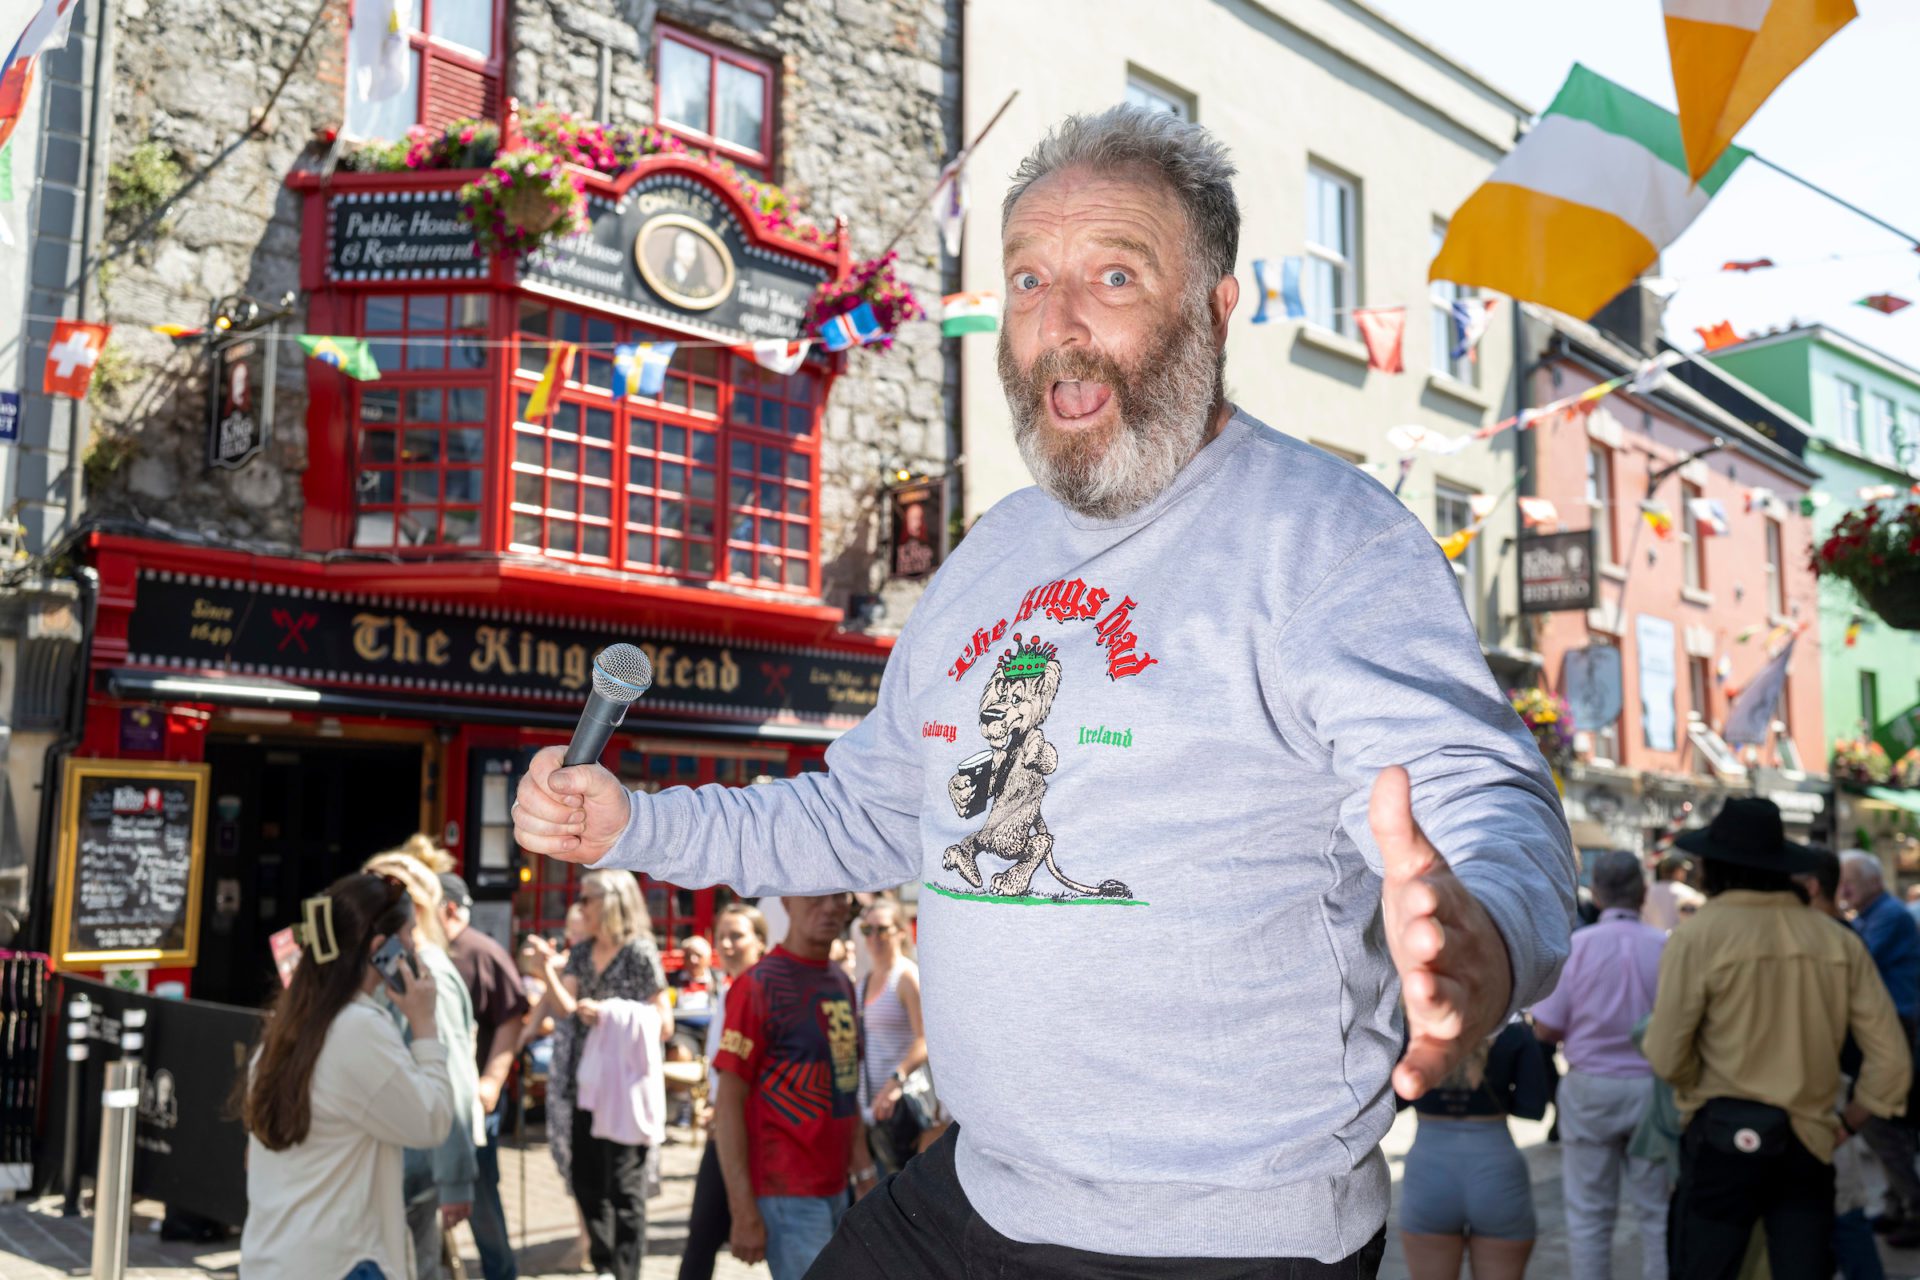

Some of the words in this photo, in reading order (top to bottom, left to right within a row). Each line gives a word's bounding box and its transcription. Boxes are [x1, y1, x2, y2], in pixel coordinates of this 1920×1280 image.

[345, 211, 408, 238] Public
[409, 209, 473, 236] House
[362, 238, 477, 268] Restaurant
[948, 618, 1008, 682] The
[1010, 578, 1110, 630] Kings
[351, 612, 450, 664] The
[470, 624, 604, 690] King
[922, 720, 957, 743] Galway
[1078, 725, 1133, 748] Ireland
[821, 1001, 857, 1040] 35
